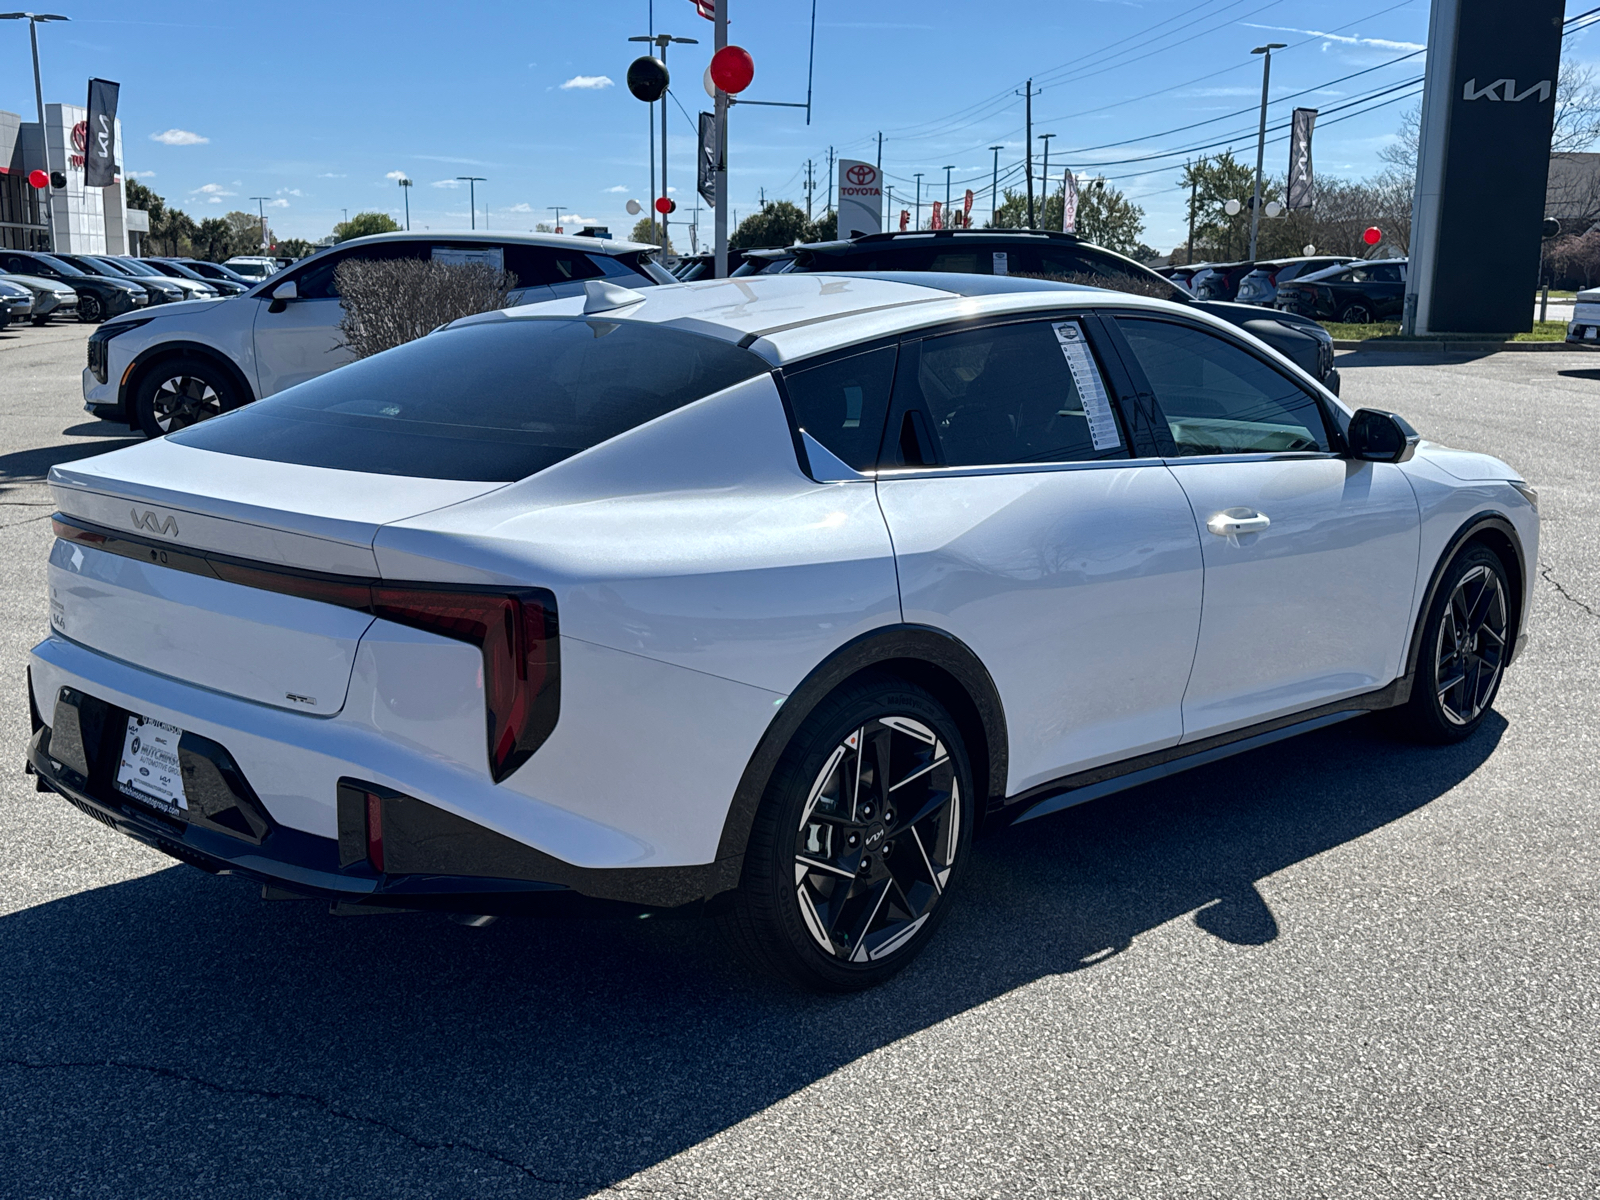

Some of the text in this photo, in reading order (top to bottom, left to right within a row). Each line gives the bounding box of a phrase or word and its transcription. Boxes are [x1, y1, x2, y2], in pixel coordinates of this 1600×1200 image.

[1463, 78, 1551, 102] KIA
[98, 114, 109, 158] KIA
[1299, 142, 1308, 181] KIA
[841, 187, 881, 196] TOYOTA
[130, 507, 179, 537] KIA
[140, 745, 180, 769] HUTCHINSO
[865, 828, 885, 846] KIA
